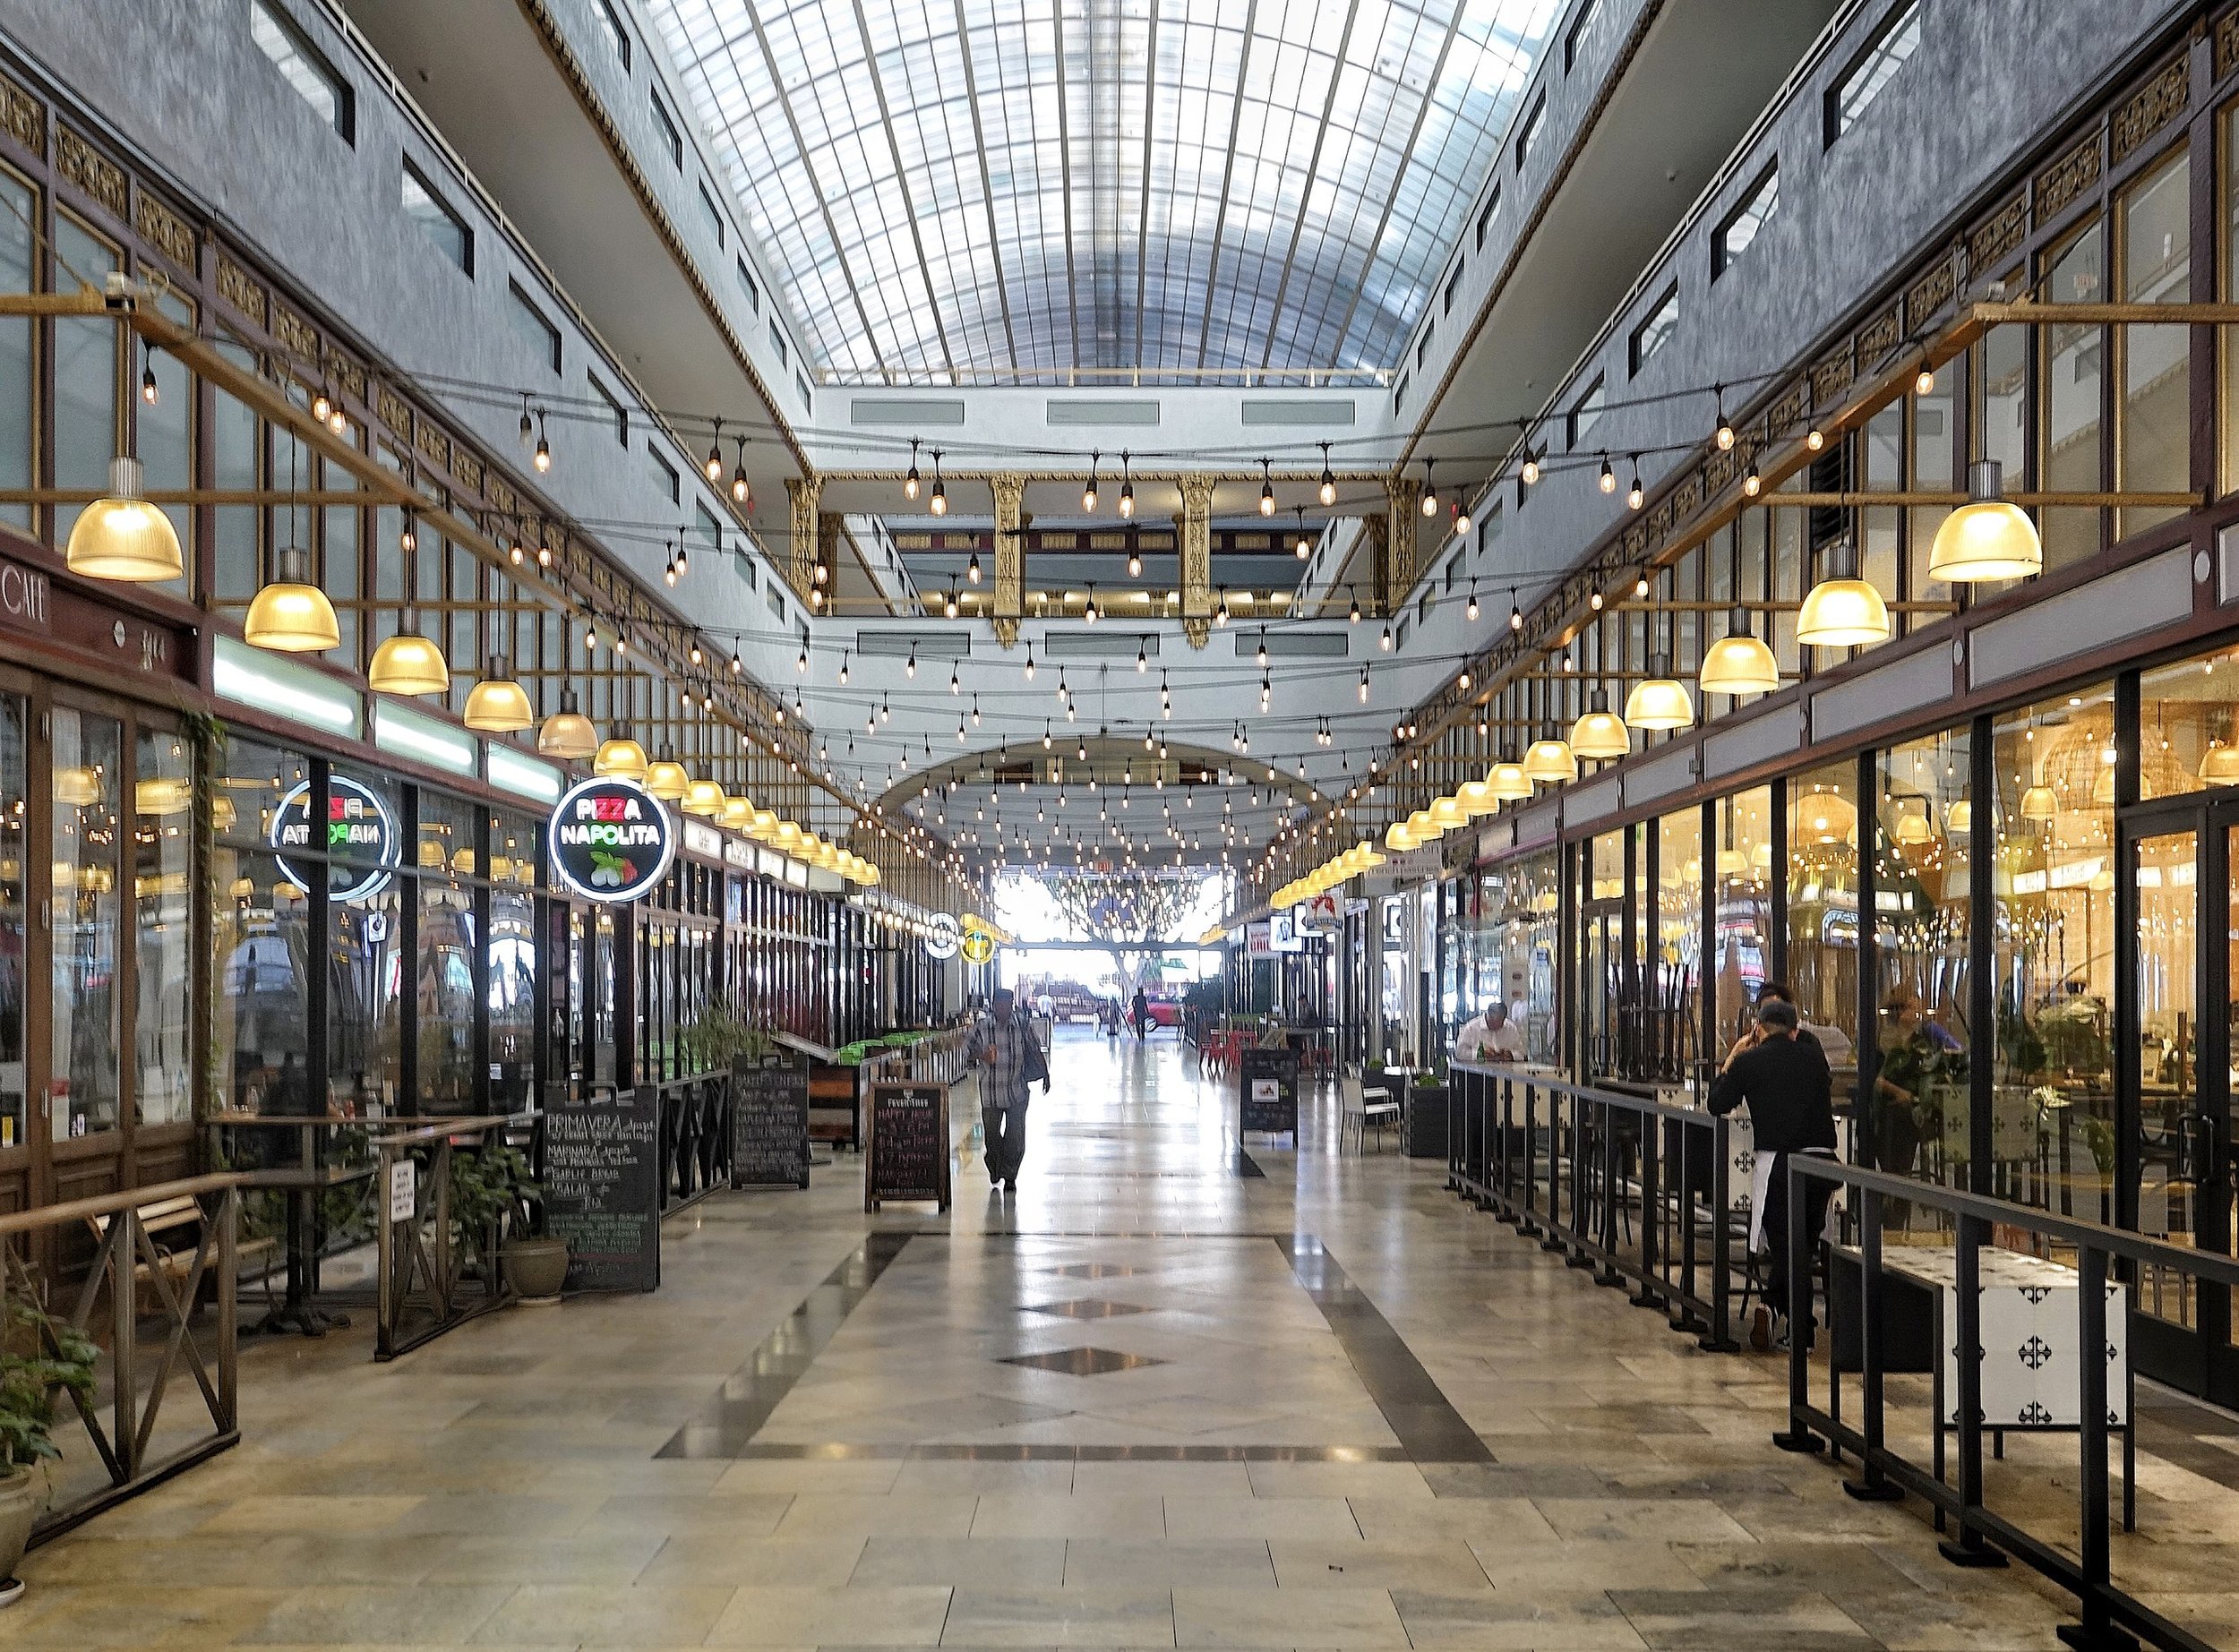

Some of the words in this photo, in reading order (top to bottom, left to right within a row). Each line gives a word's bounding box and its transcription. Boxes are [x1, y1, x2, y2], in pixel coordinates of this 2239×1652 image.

[576, 796, 643, 821] PIZZA
[561, 824, 661, 845] NAPOLITA
[547, 1114, 622, 1134] PRIMAVERA
[546, 1144, 598, 1159] MARINARA
